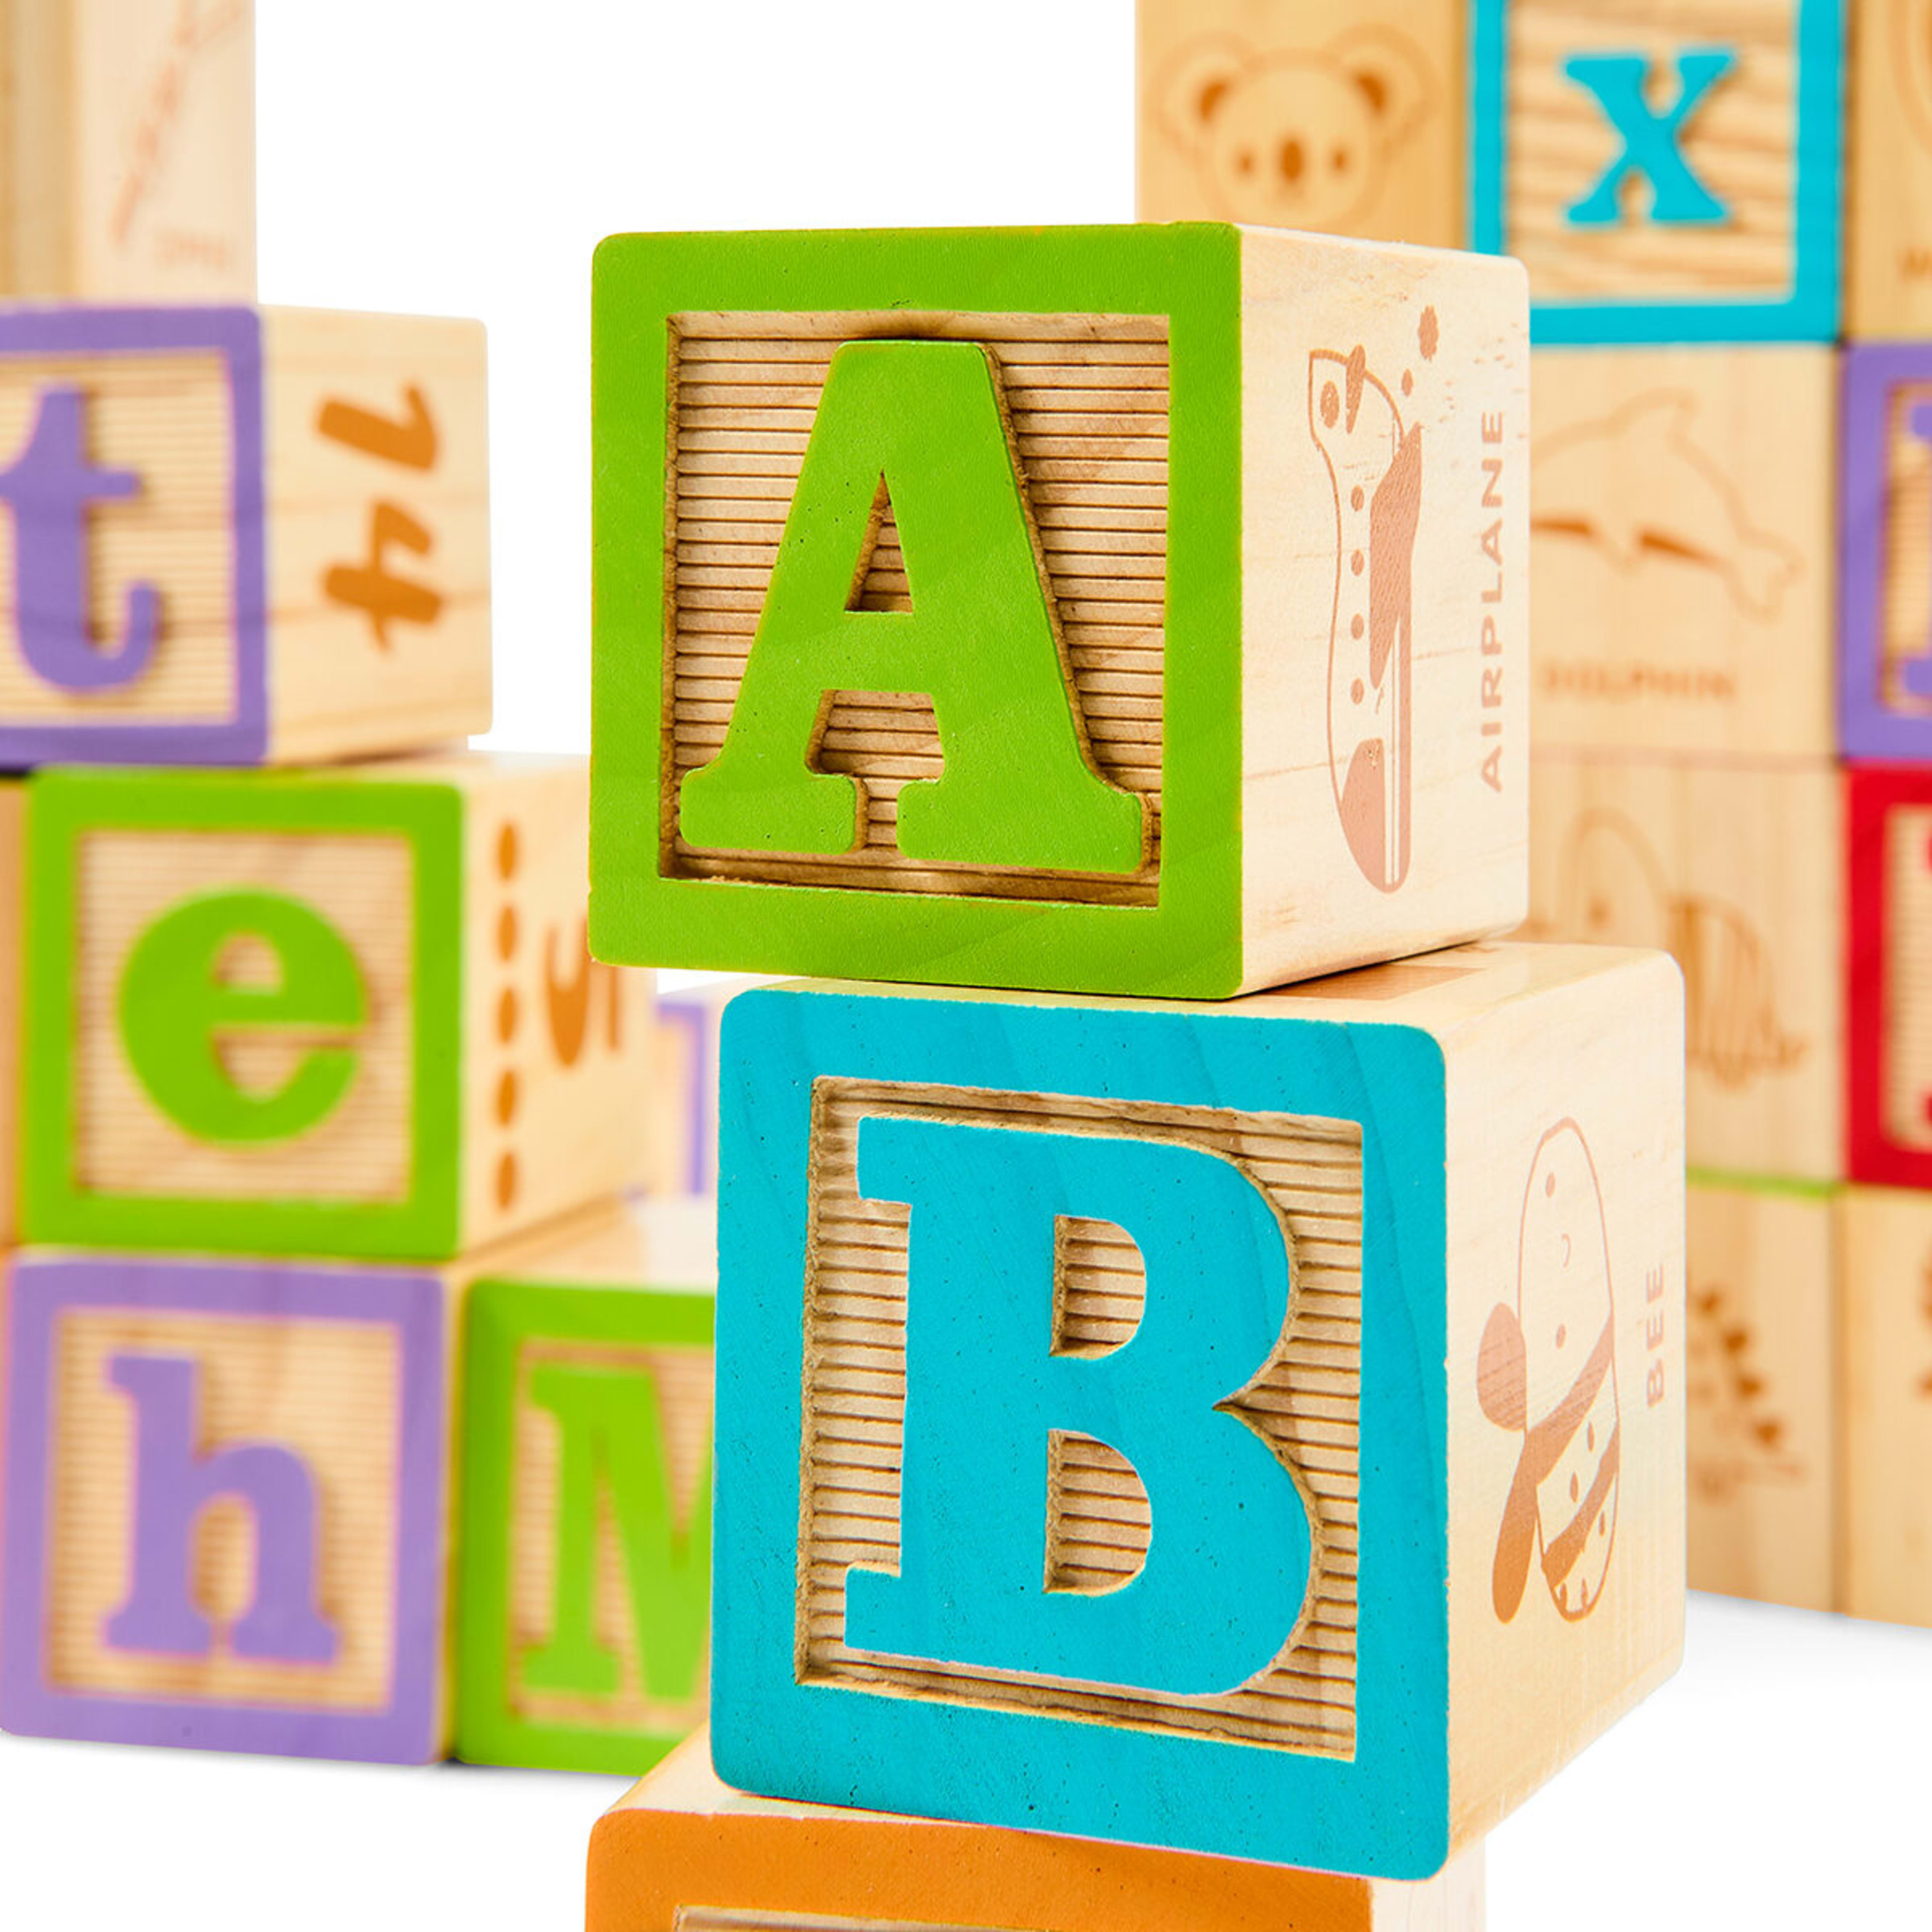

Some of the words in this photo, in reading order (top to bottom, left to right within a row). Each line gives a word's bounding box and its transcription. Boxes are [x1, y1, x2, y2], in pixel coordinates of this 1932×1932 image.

[0, 385, 160, 693] t
[316, 383, 447, 651] 14
[679, 339, 1150, 875] A
[1481, 410, 1504, 793] AIRPLANE
[119, 887, 365, 1145] e
[844, 1117, 1312, 1695] B
[1646, 1263, 1664, 1408] BEE
[106, 1354, 339, 1663] h
